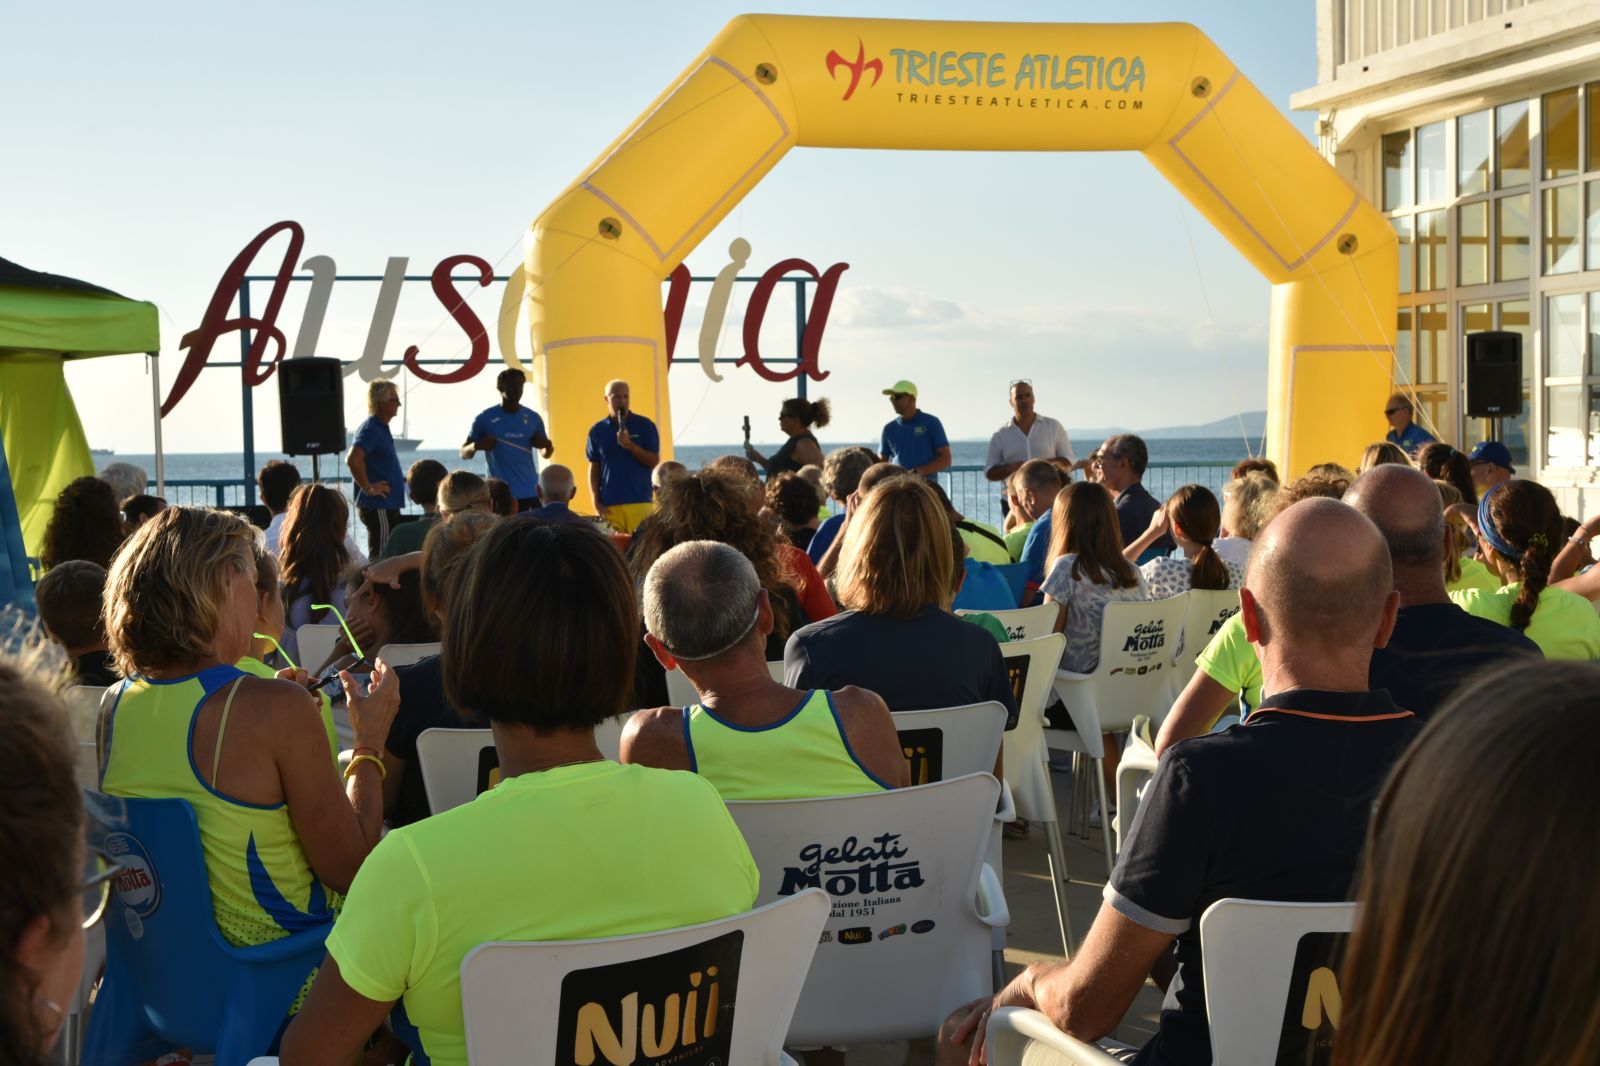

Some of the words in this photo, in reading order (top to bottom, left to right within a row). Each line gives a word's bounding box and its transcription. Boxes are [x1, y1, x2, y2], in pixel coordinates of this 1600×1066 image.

[889, 48, 1007, 88] TRIESTE
[1014, 53, 1146, 93] ATLETICA
[896, 93, 1143, 110] TRIESTEATLETICA.COM
[1133, 619, 1165, 638] gelati
[1122, 634, 1166, 652] Motta
[799, 832, 908, 875] gelati
[777, 860, 926, 896] Motta
[863, 896, 902, 907] Italiana
[849, 907, 876, 918] 1951
[574, 965, 719, 1066] Nuii
